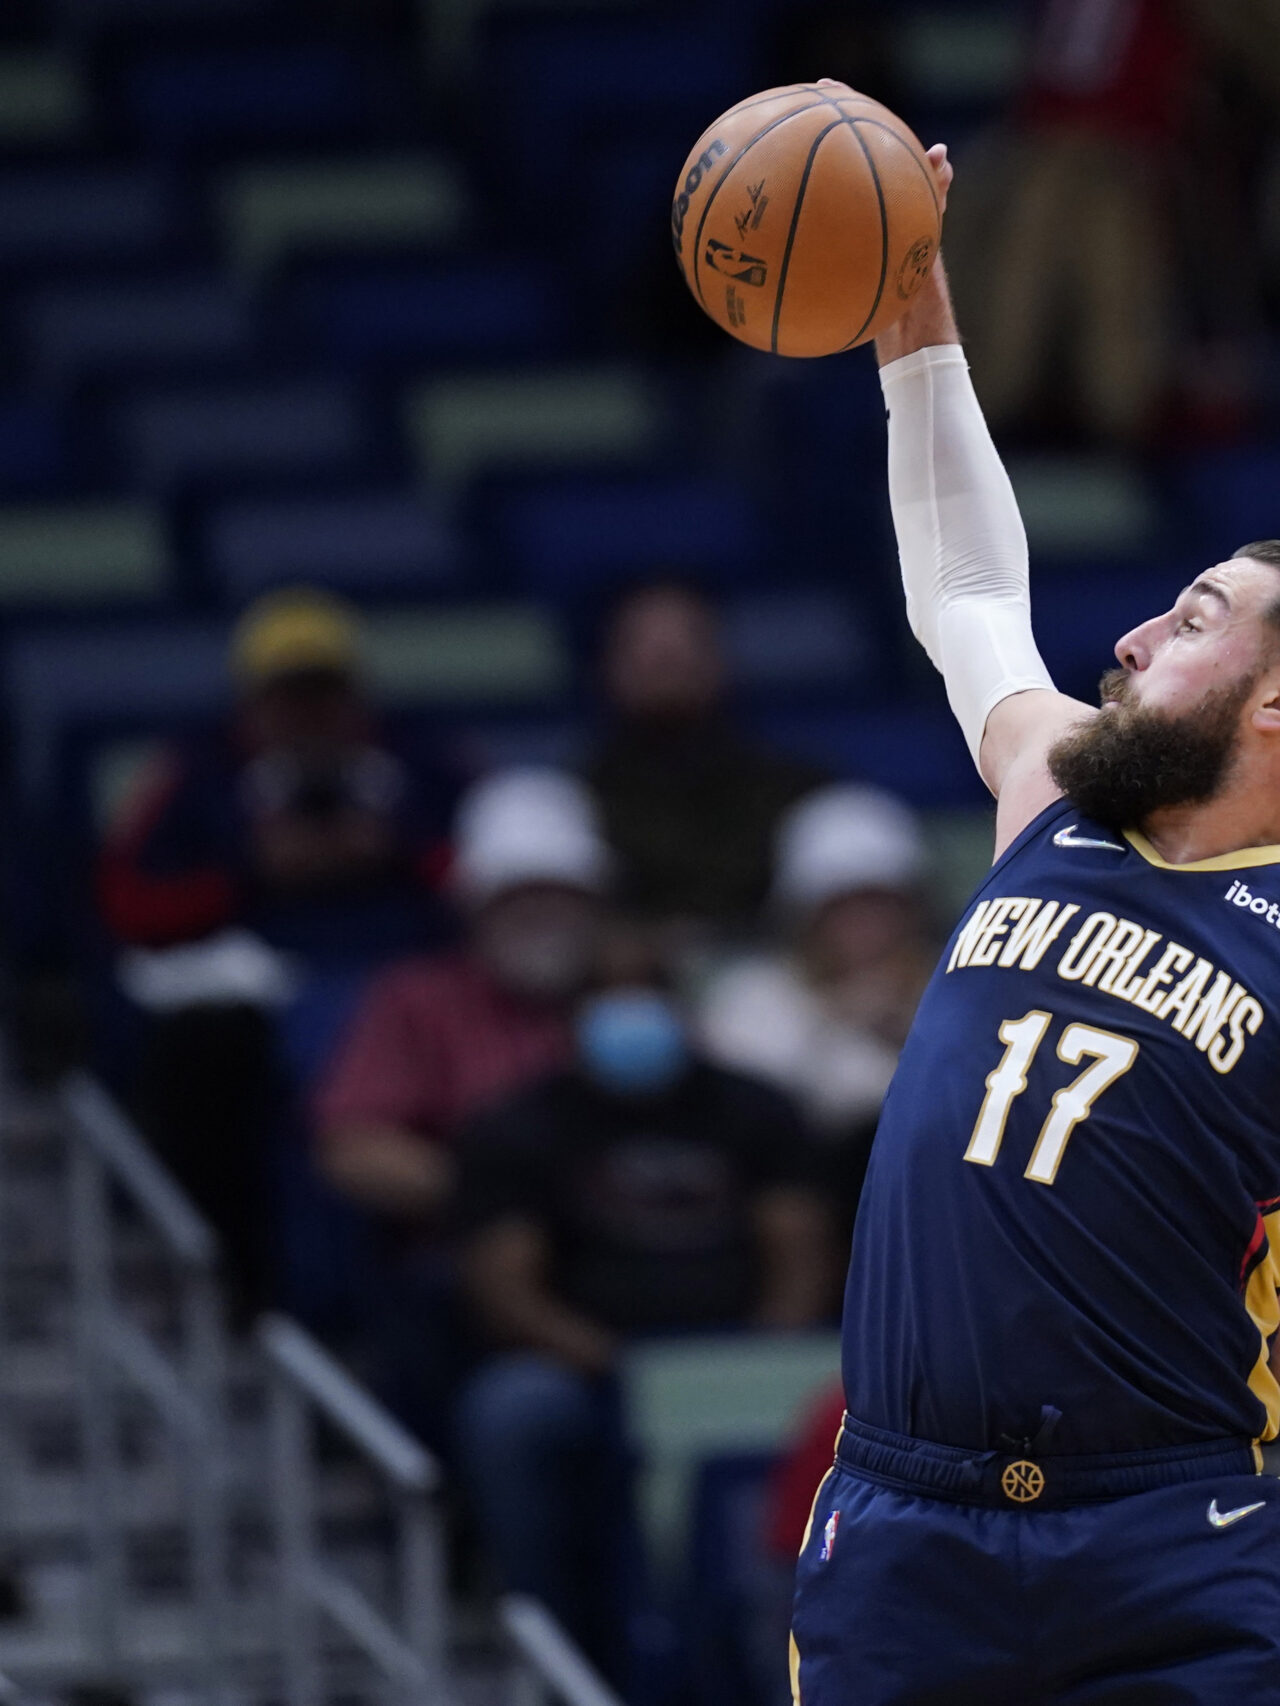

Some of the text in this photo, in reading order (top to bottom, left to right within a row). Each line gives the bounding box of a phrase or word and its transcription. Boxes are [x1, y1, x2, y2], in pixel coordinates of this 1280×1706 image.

[945, 896, 1265, 1075] NEW ORLEANS
[962, 1009, 1140, 1186] 17
